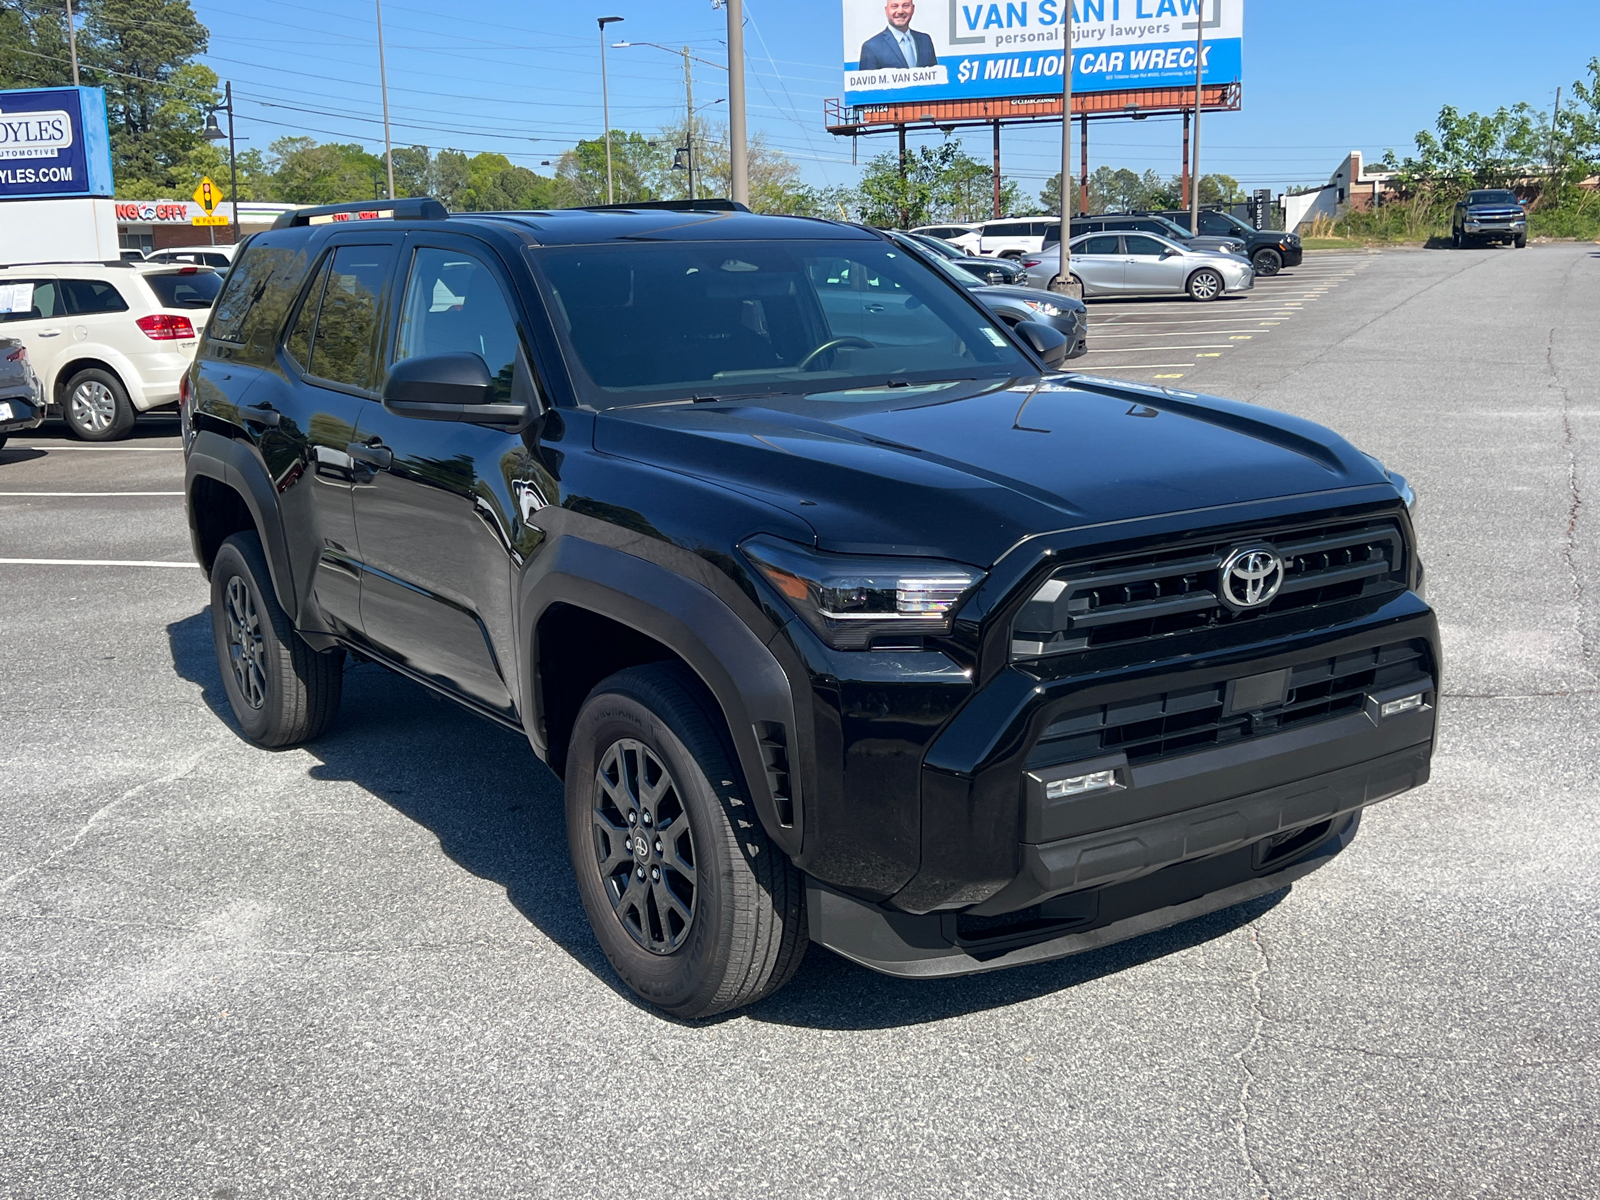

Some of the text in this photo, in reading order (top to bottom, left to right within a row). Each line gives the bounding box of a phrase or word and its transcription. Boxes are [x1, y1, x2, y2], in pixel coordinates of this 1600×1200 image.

[962, 1, 1027, 31] VAN
[996, 28, 1058, 47] personal
[1110, 23, 1170, 38] lawyers
[957, 59, 980, 84] $1
[1080, 51, 1125, 74] CAR
[1130, 46, 1211, 70] WRECK
[850, 71, 937, 87] DAVID M. VAN SANT
[156, 204, 187, 220] CITY
